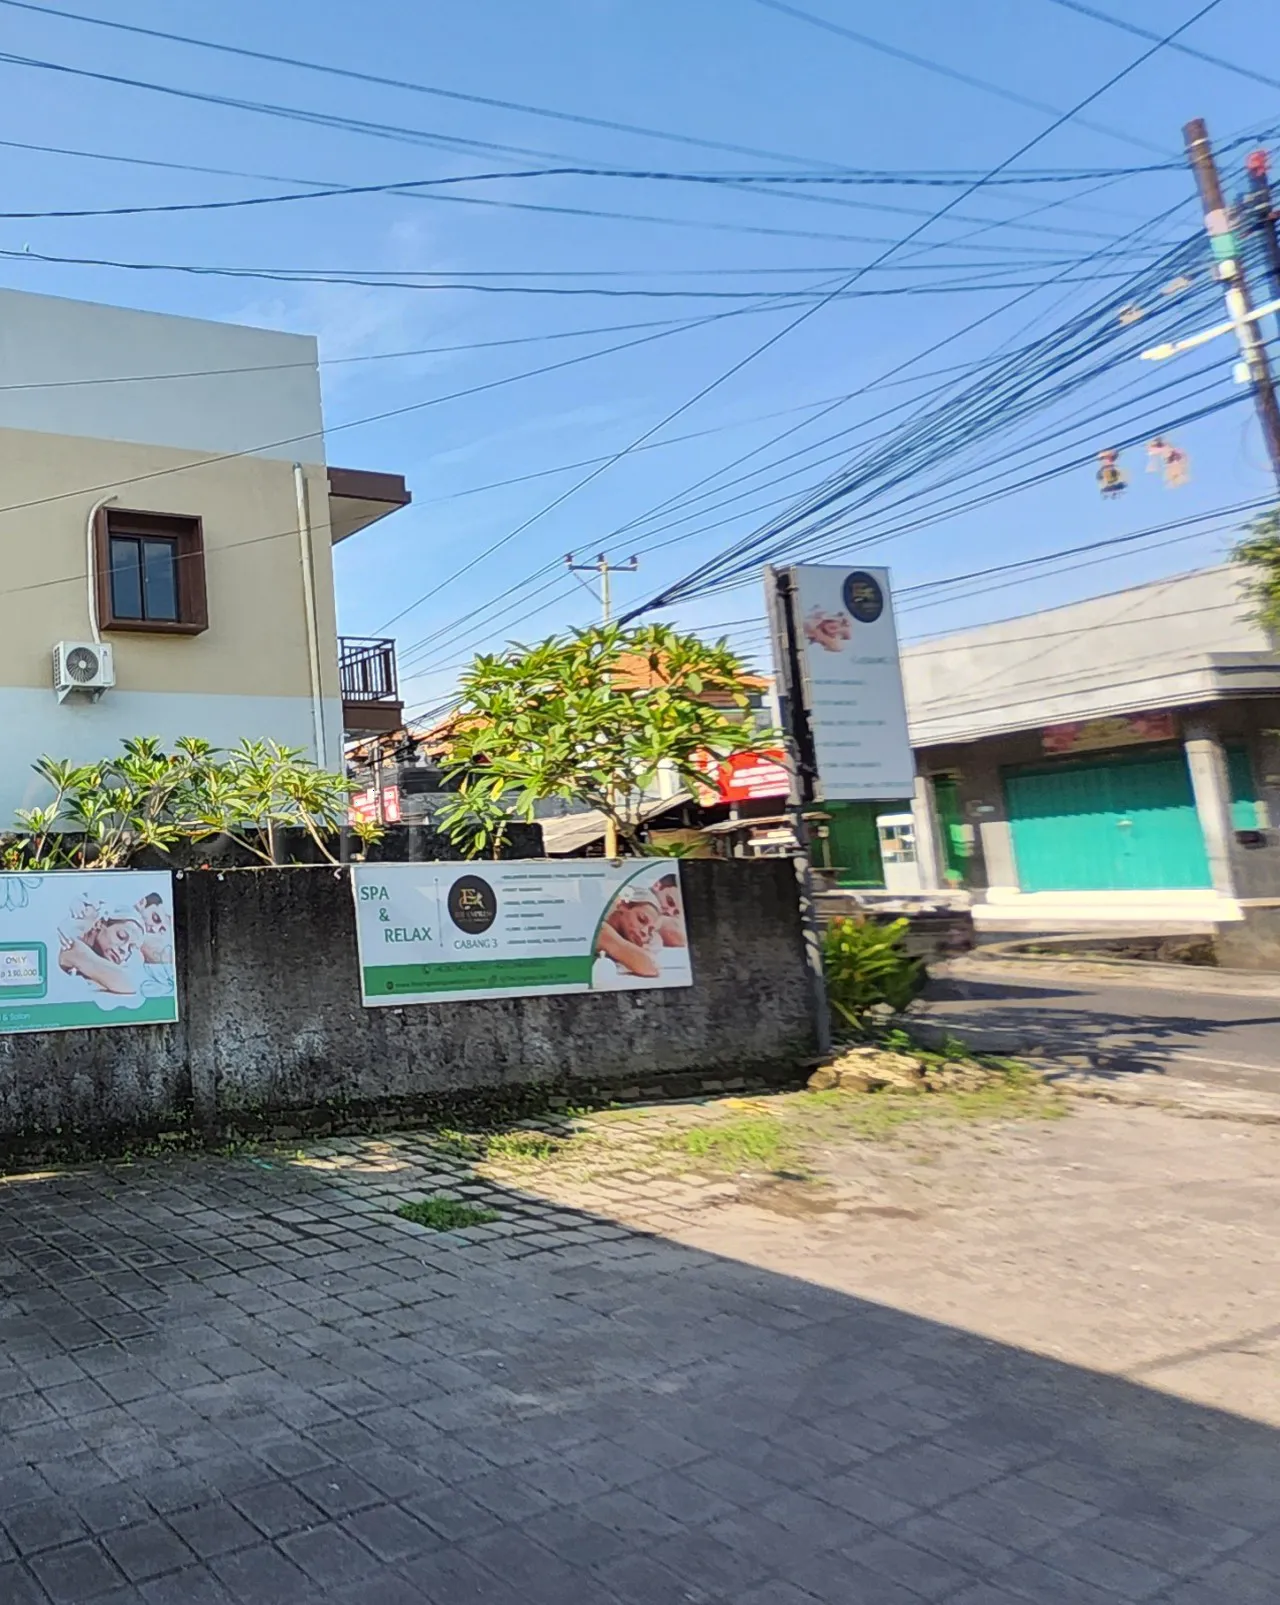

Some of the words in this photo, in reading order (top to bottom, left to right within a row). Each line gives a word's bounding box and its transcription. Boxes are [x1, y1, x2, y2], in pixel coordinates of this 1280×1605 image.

[361, 886, 390, 900] SPA
[379, 907, 390, 922] &
[384, 927, 433, 943] RELAX
[454, 939, 490, 949] CABANG
[492, 938, 498, 948] 3
